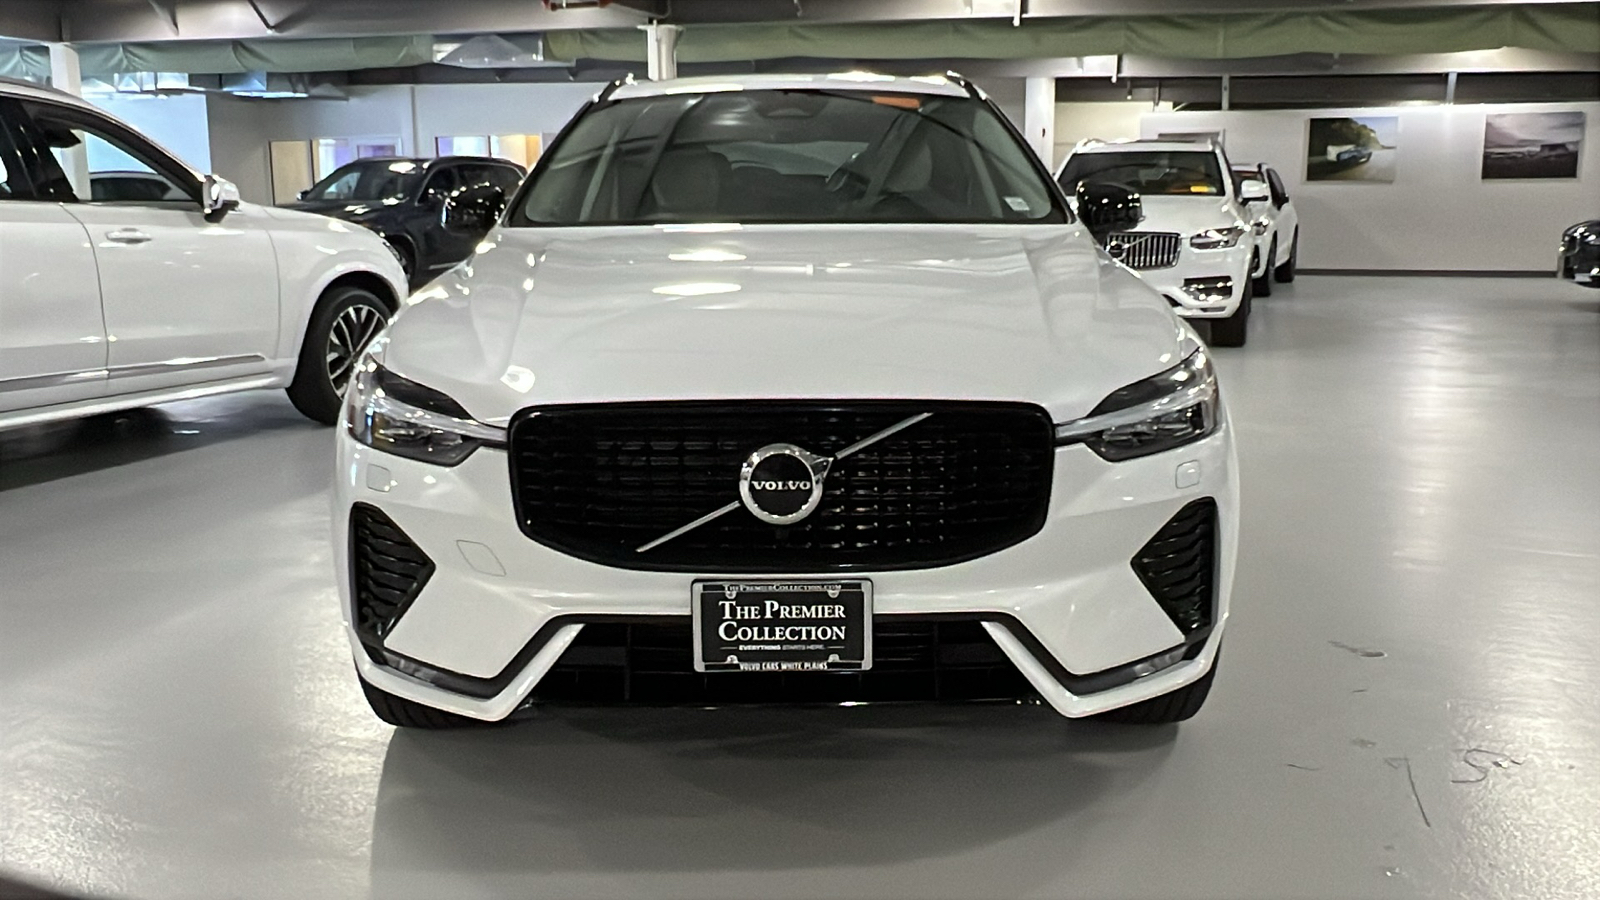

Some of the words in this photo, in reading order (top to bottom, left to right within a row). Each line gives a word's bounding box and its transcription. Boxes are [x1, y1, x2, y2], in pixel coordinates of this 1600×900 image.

[751, 480, 811, 490] VOLVO
[718, 600, 761, 619] THE
[763, 600, 846, 619] PREMIER
[718, 621, 846, 641] COLLECTION
[739, 661, 760, 670] VOLVO
[762, 661, 779, 670] CARS
[781, 661, 802, 670] WHITE
[803, 661, 828, 670] PLAINS
